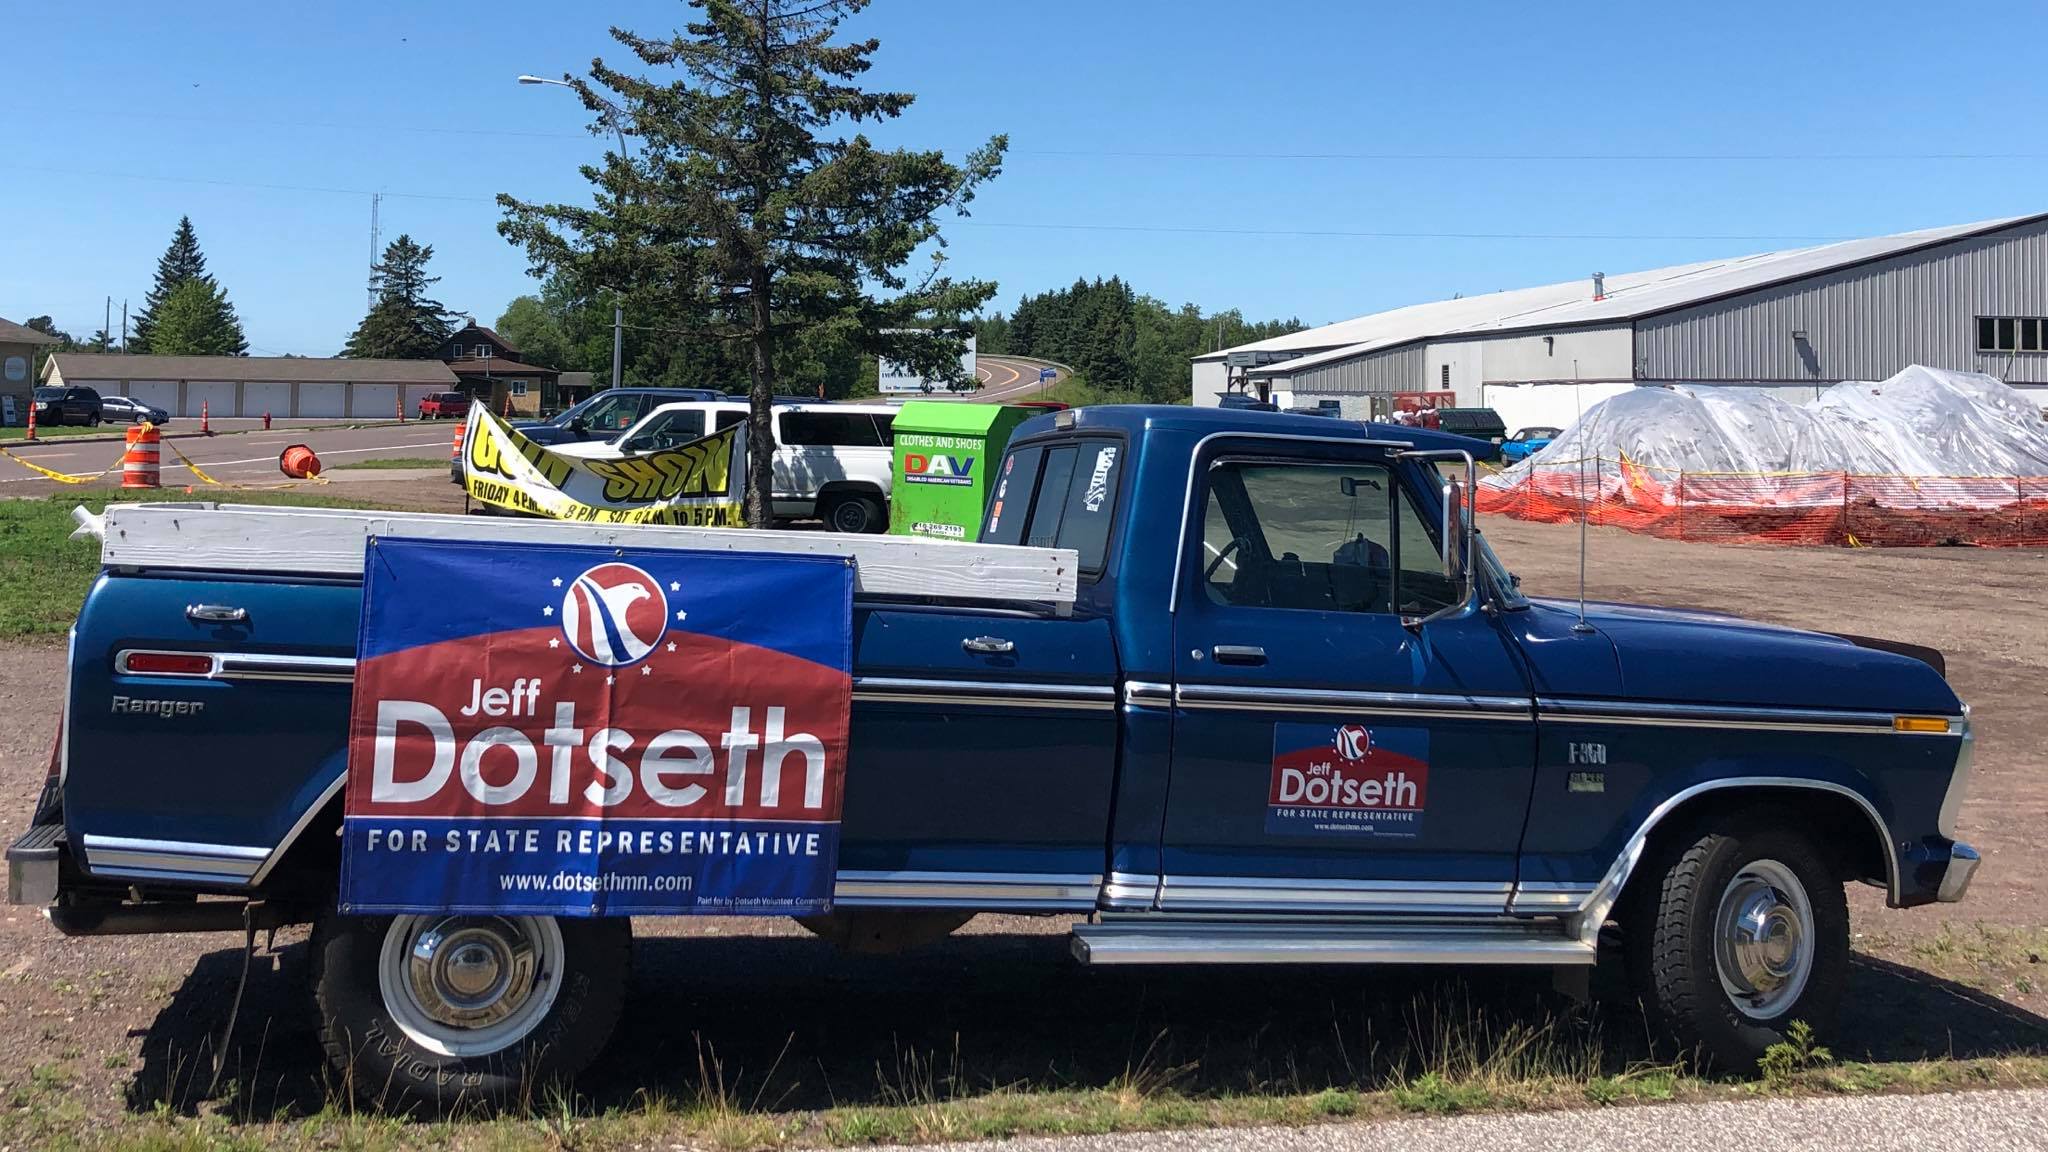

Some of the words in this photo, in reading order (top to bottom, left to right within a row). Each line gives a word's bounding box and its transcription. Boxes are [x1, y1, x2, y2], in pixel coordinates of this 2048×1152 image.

[900, 434, 933, 447] CLOTHES
[935, 437, 954, 448] AND
[955, 438, 982, 450] SHOES
[582, 426, 736, 502] SHOW
[904, 453, 975, 477] DAV
[473, 479, 510, 504] FRIDAY
[672, 509, 688, 526] to
[111, 695, 205, 719] Ranger
[460, 678, 541, 717] Jeff
[371, 699, 826, 809] Dotseth
[1306, 761, 1331, 776] Jeff
[1279, 768, 1417, 806] Dotseth
[1276, 808, 1296, 818] FOR
[1299, 809, 1329, 819] STATE
[1332, 810, 1414, 821] REPRESENTATIVE
[367, 829, 428, 852] FOR
[445, 829, 540, 853] STATE
[556, 829, 820, 856] REPRESENTATIVE
[499, 870, 693, 892] www.dotsethmn.com
[697, 896, 712, 905] Paid
[713, 896, 724, 905] for
[724, 896, 734, 907] by
[735, 897, 761, 906] Dotseth
[762, 897, 794, 906] Volunteer
